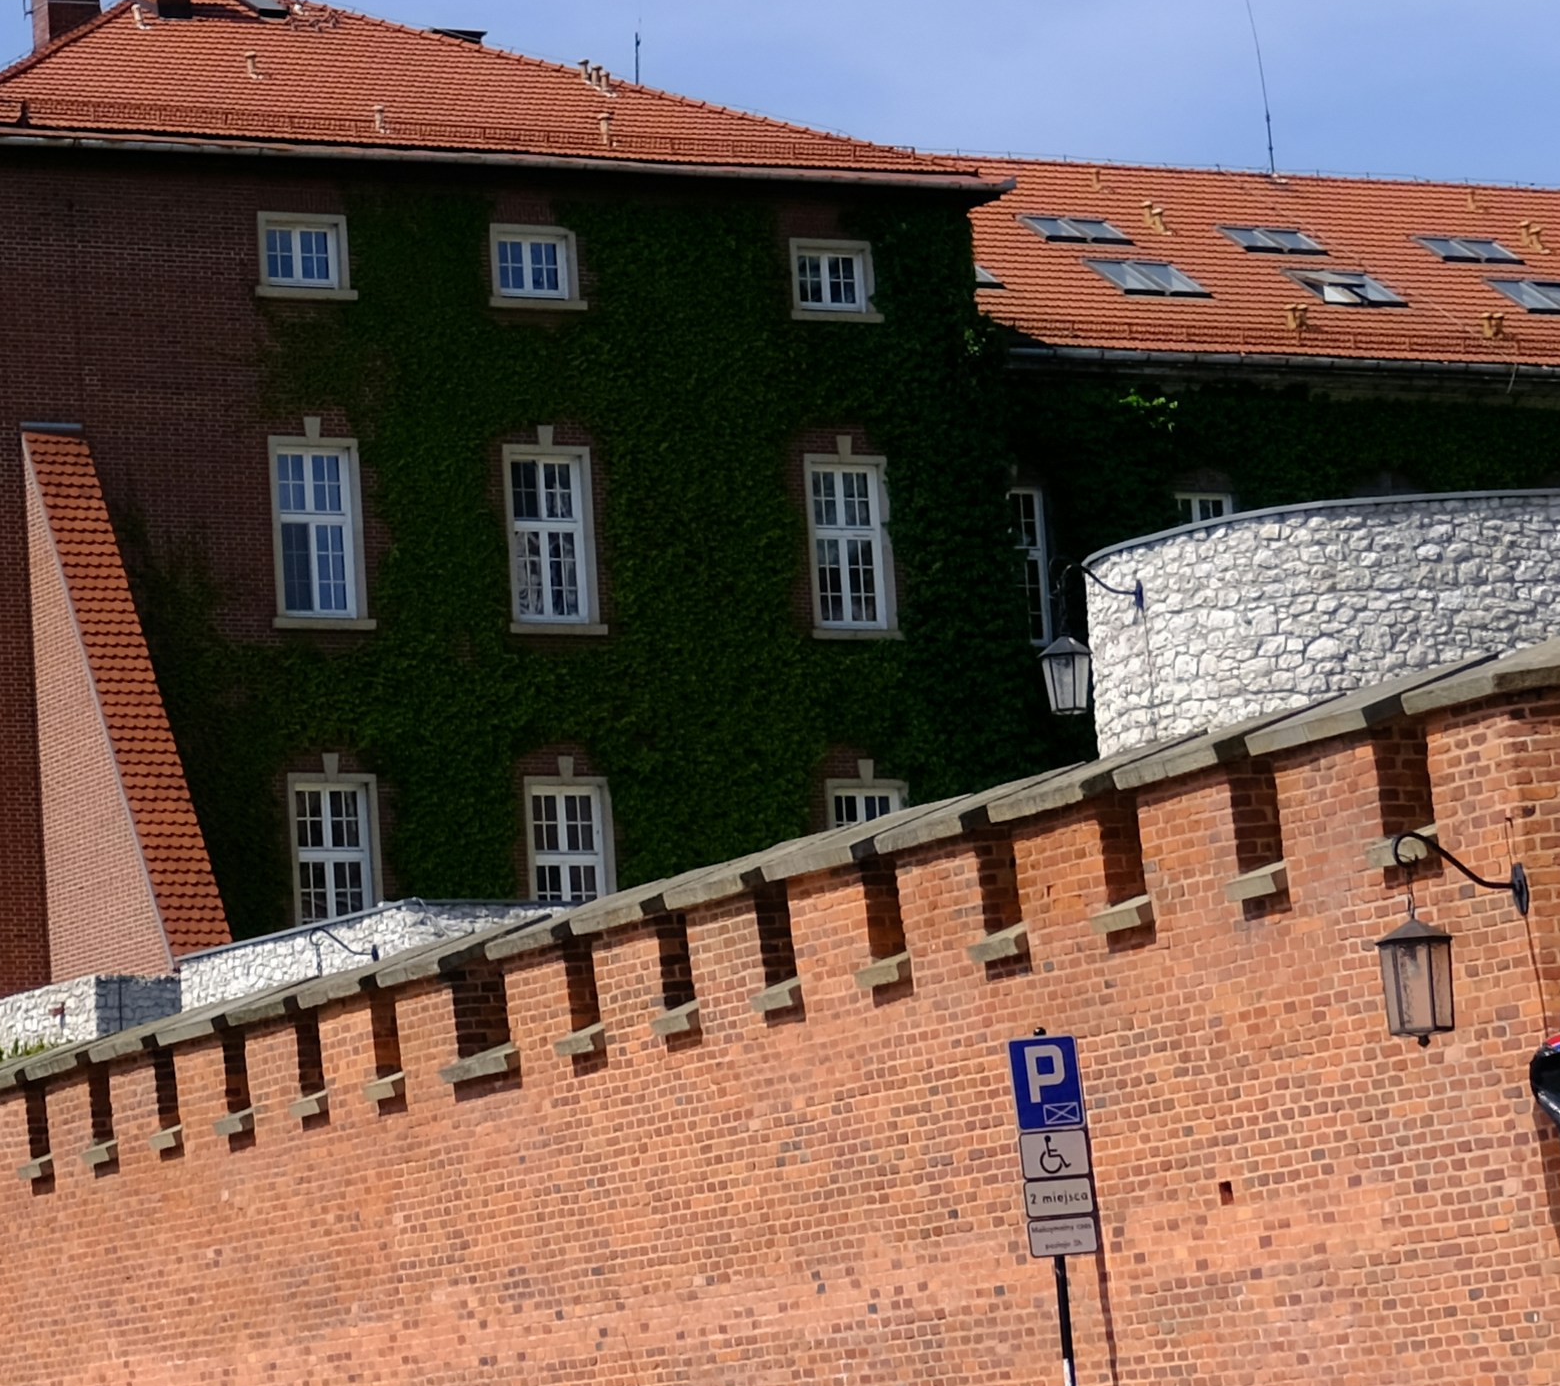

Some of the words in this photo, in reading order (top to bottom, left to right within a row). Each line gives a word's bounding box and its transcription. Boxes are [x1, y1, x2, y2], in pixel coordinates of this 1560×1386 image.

[1024, 1044, 1065, 1103] P
[1030, 1193, 1037, 1205] 2
[1042, 1190, 1089, 1205] miejsca
